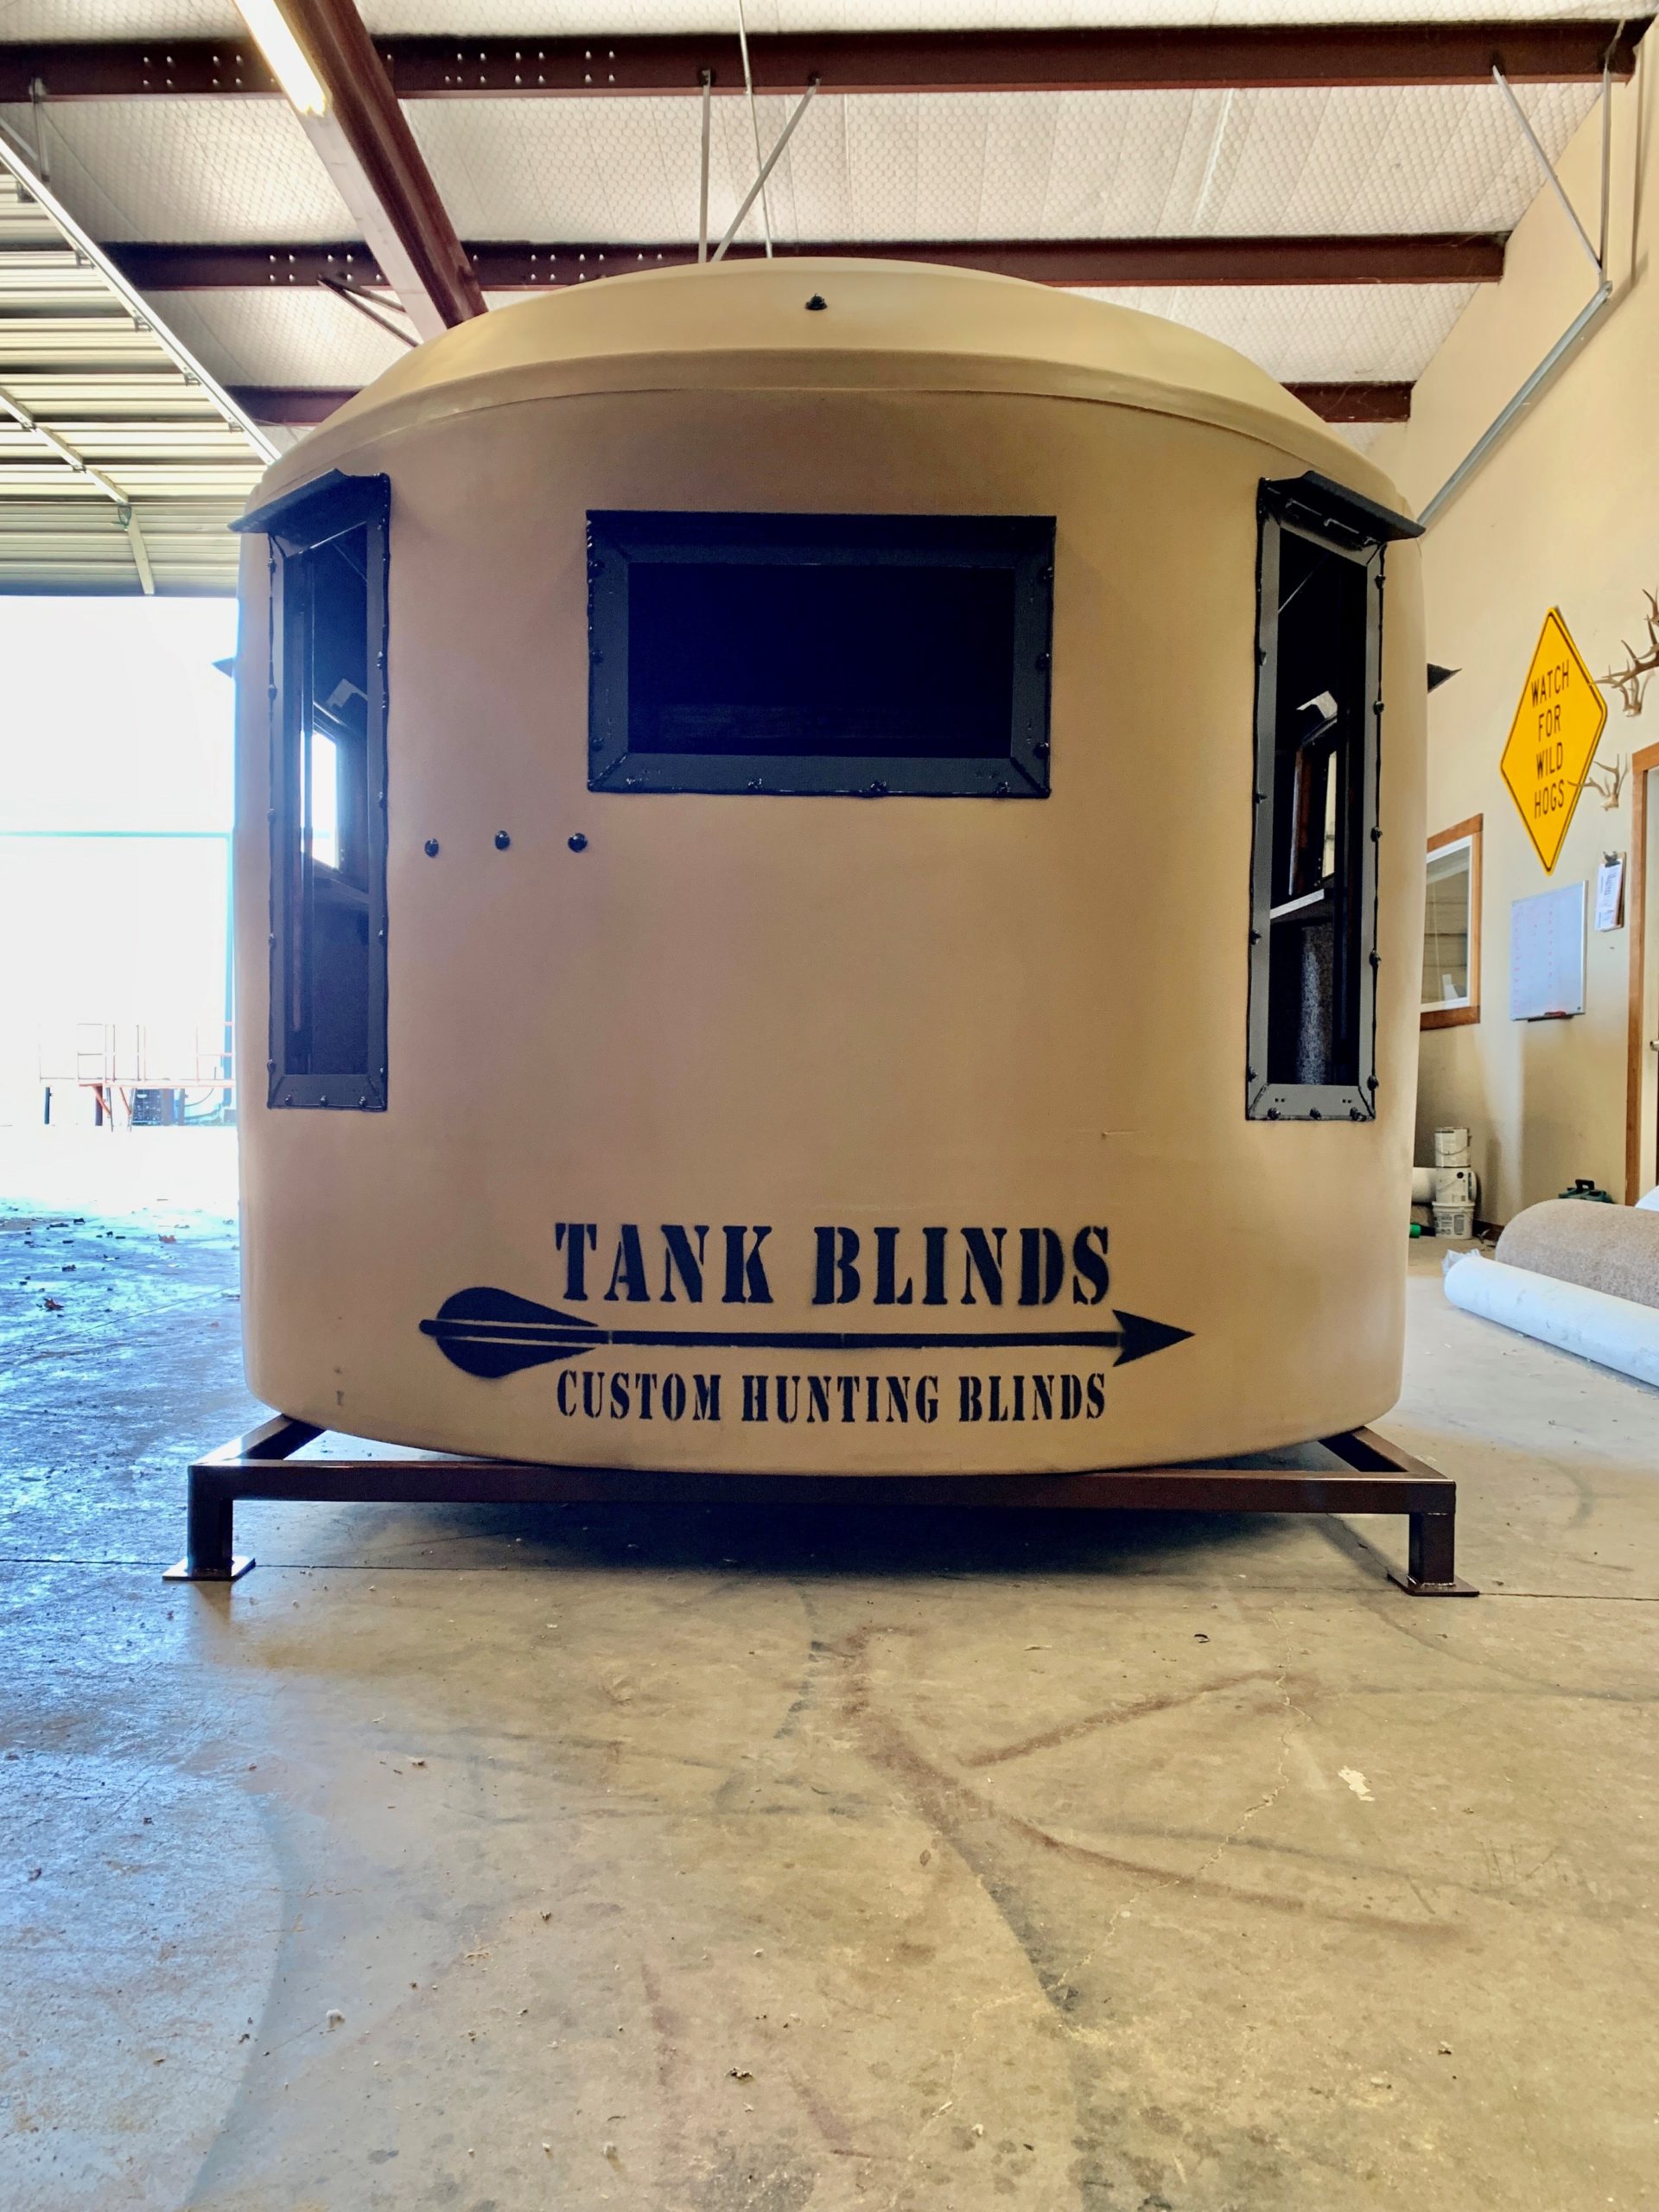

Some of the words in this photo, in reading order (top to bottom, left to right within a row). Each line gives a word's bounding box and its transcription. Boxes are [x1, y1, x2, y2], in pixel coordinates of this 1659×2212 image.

[1532, 660, 1569, 708] WATCH
[1538, 704, 1561, 741] FOR
[1536, 742, 1563, 779] WILD
[1535, 779, 1564, 818] HOGS
[555, 1223, 773, 1304] TANK
[812, 1226, 1110, 1306] BLINDS
[556, 1370, 721, 1421] CUSTOM
[741, 1374, 939, 1424] HUNTING
[958, 1372, 1106, 1423] BLINDS
